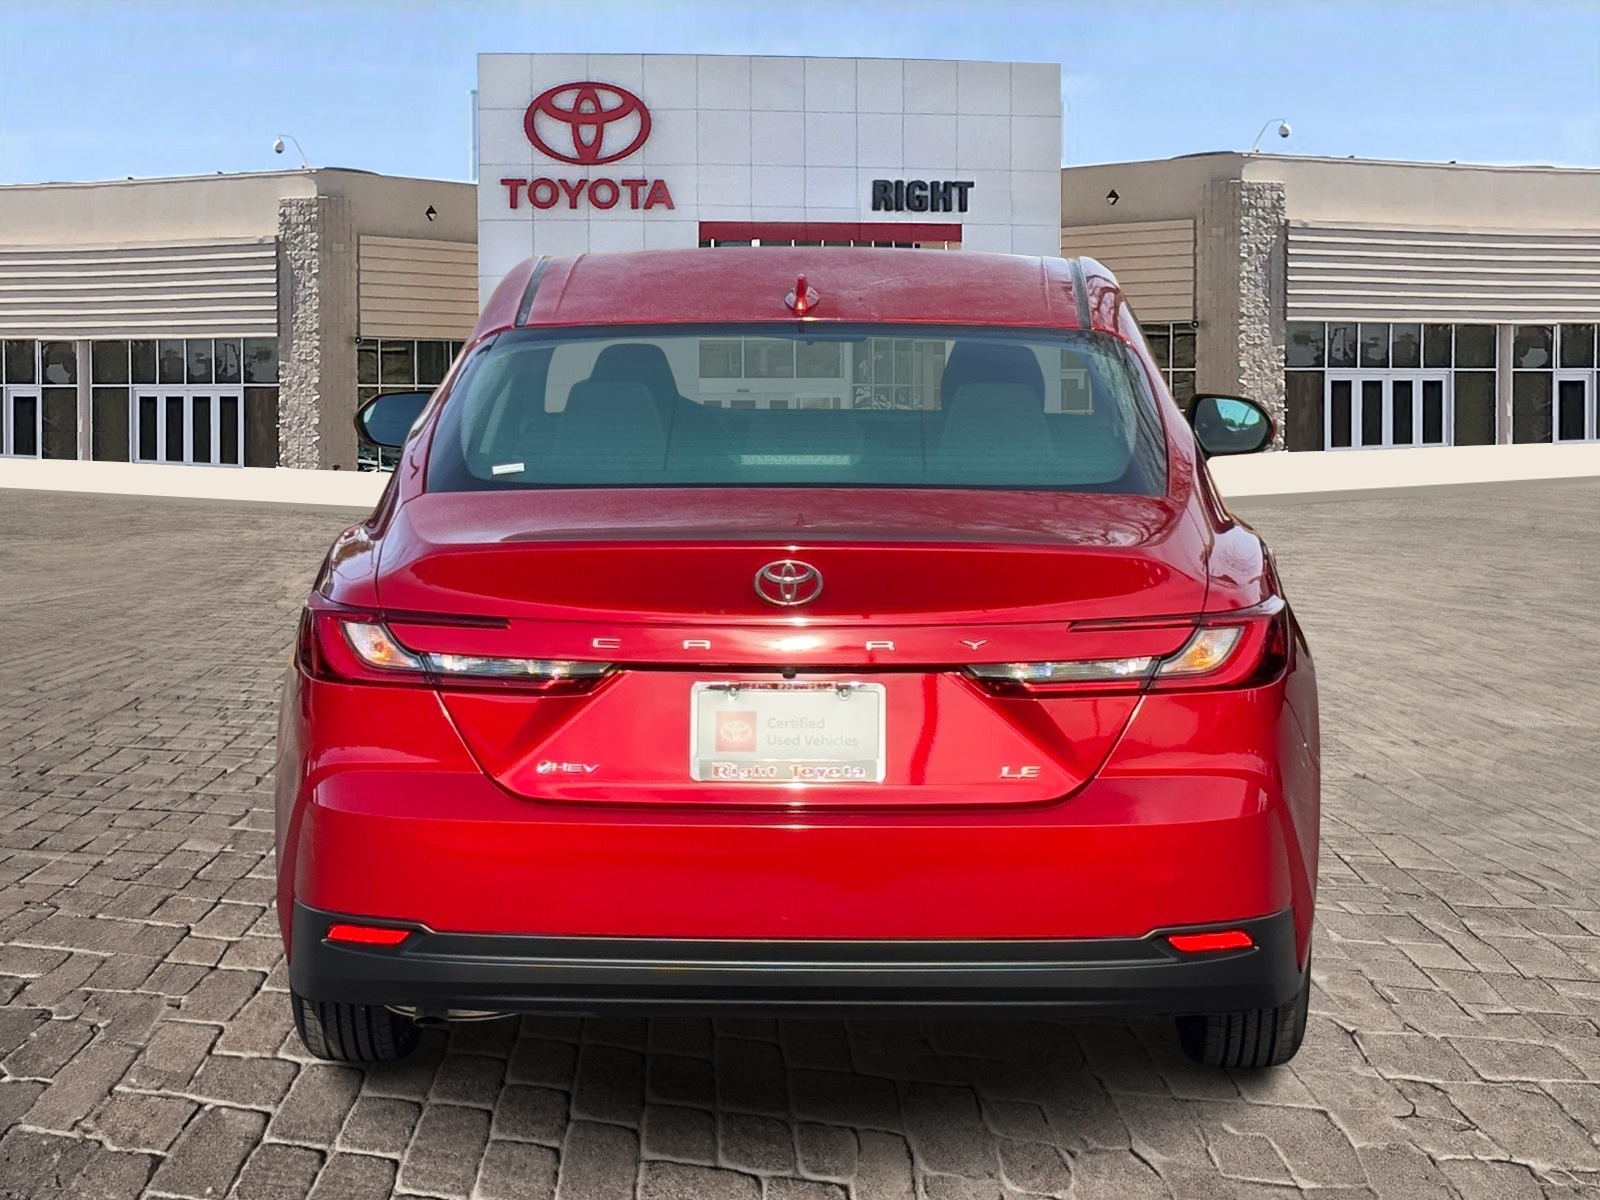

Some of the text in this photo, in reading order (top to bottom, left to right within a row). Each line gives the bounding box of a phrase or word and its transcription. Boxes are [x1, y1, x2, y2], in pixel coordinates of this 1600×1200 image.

[501, 178, 675, 210] TOYOTA
[872, 179, 975, 213] RIGHT
[592, 637, 988, 651] CARY
[767, 716, 826, 730] Certified
[766, 733, 859, 747] Used Vehicles
[551, 762, 599, 773] HEV
[711, 762, 867, 780] Right Toyota
[1000, 764, 1041, 779] LE
